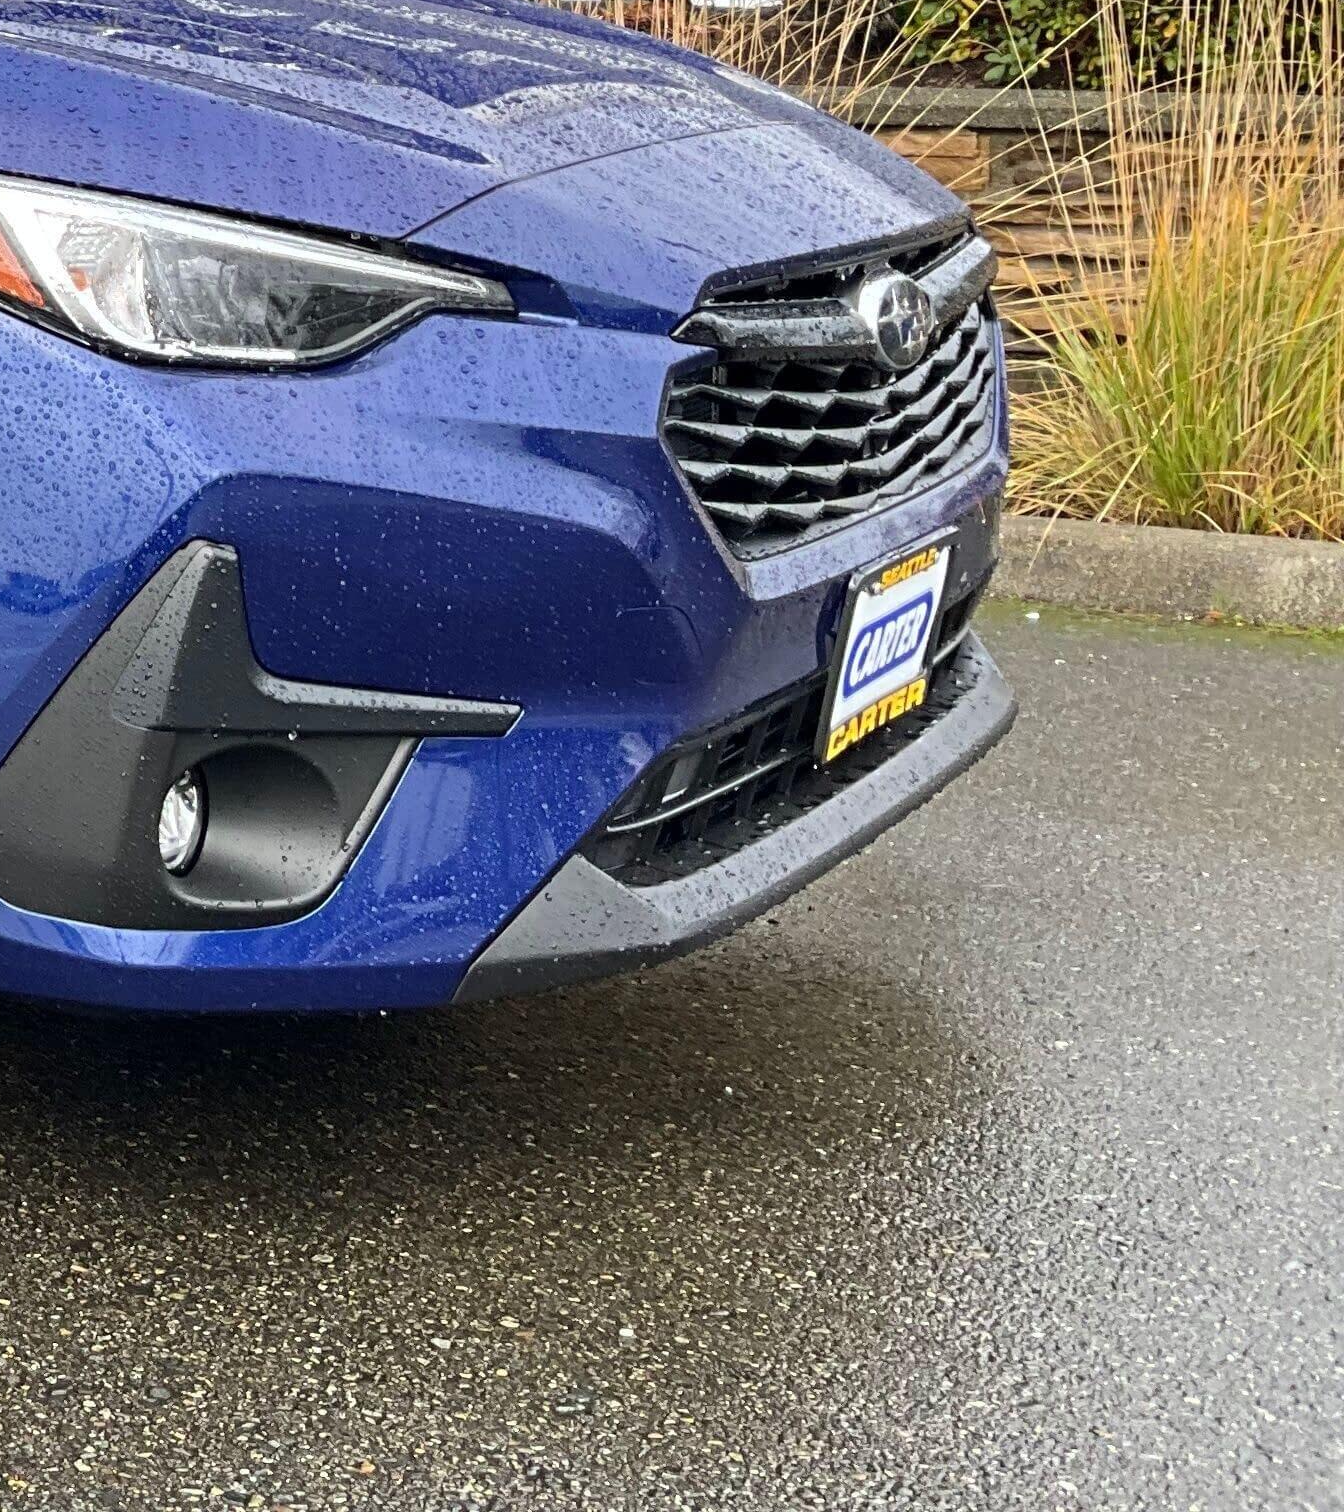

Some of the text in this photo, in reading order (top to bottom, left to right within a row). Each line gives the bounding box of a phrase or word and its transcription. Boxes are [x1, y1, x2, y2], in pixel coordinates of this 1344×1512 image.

[881, 547, 937, 589] SEATTLE
[849, 602, 928, 687] CARTER
[826, 678, 926, 762] CARTER
